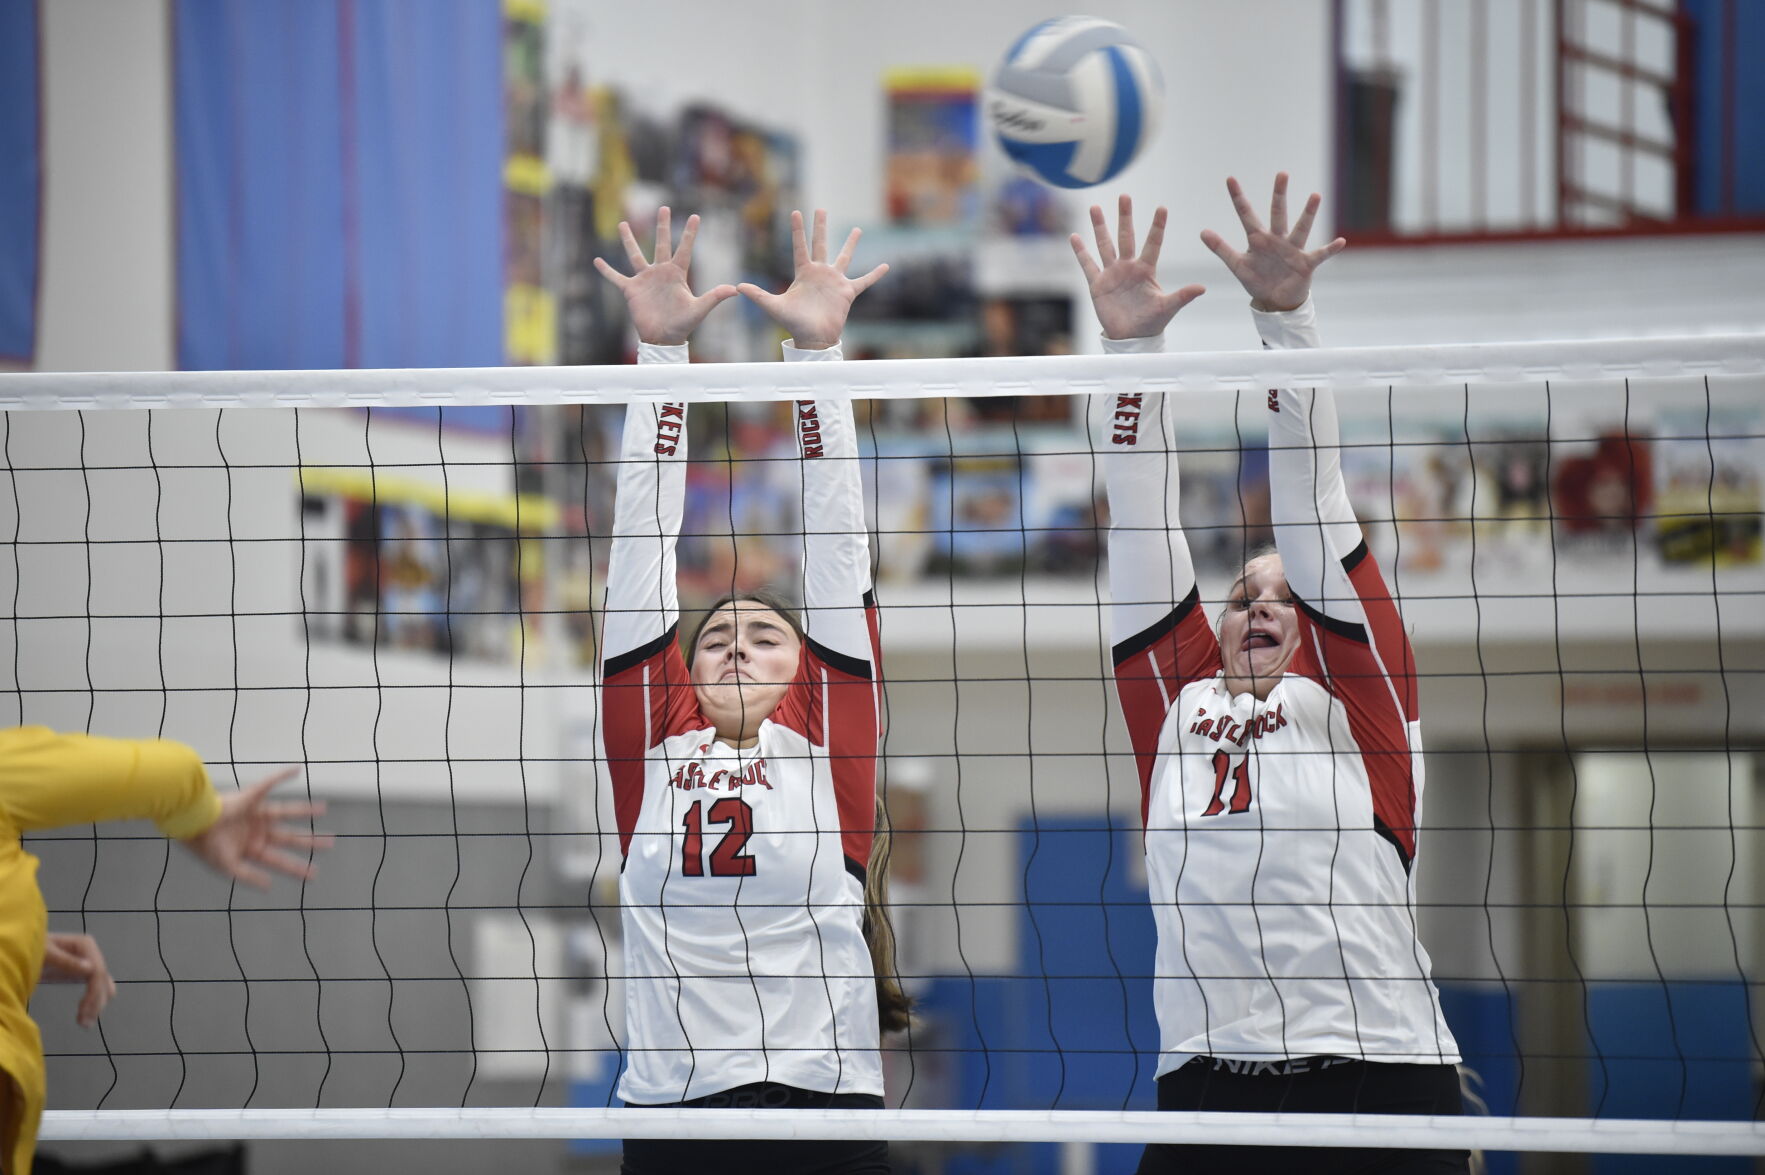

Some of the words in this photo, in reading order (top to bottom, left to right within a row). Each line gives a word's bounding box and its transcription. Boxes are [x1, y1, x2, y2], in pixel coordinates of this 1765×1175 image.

[653, 402, 684, 457] KETS
[1111, 392, 1143, 446] KETS
[1200, 748, 1252, 817] 11
[682, 796, 757, 877] 12
[1212, 1057, 1312, 1077] NIKE
